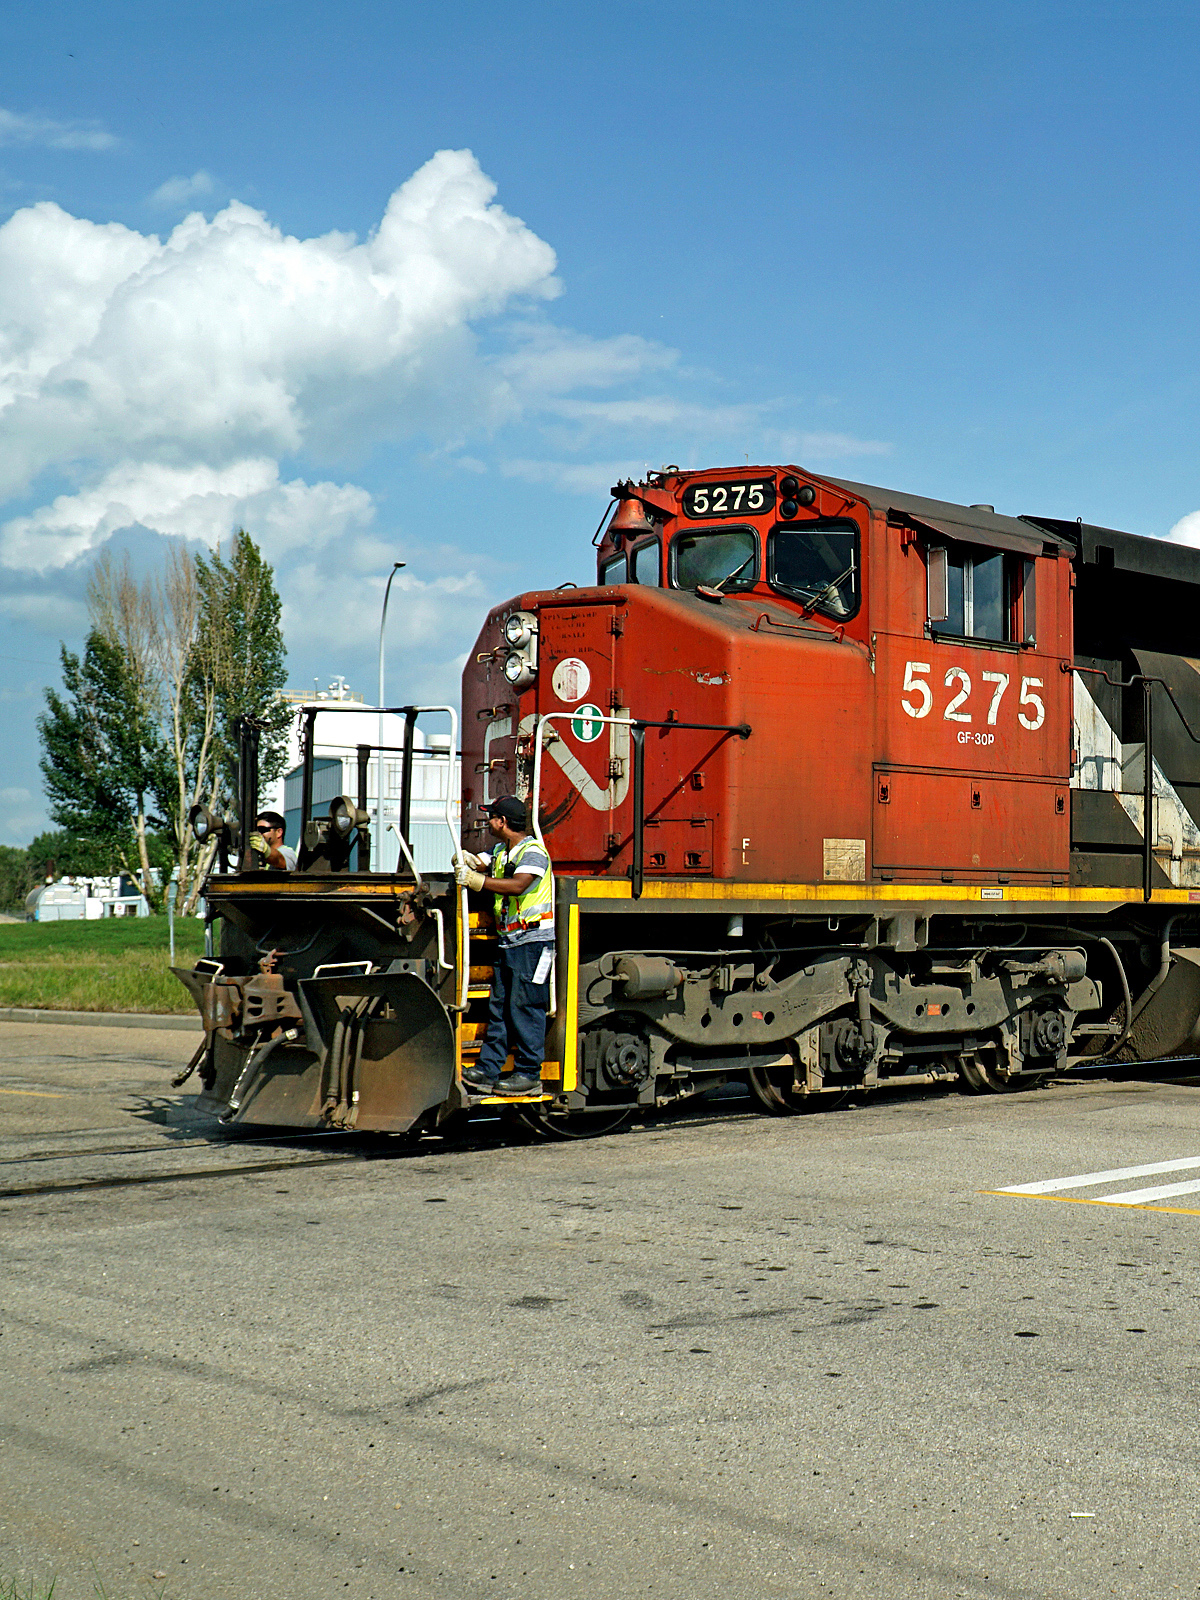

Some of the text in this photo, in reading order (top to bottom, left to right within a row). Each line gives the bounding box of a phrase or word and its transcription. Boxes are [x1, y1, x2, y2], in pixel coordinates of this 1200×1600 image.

[693, 484, 764, 514] 5275
[901, 661, 1045, 731] 5275
[742, 838, 750, 849] F
